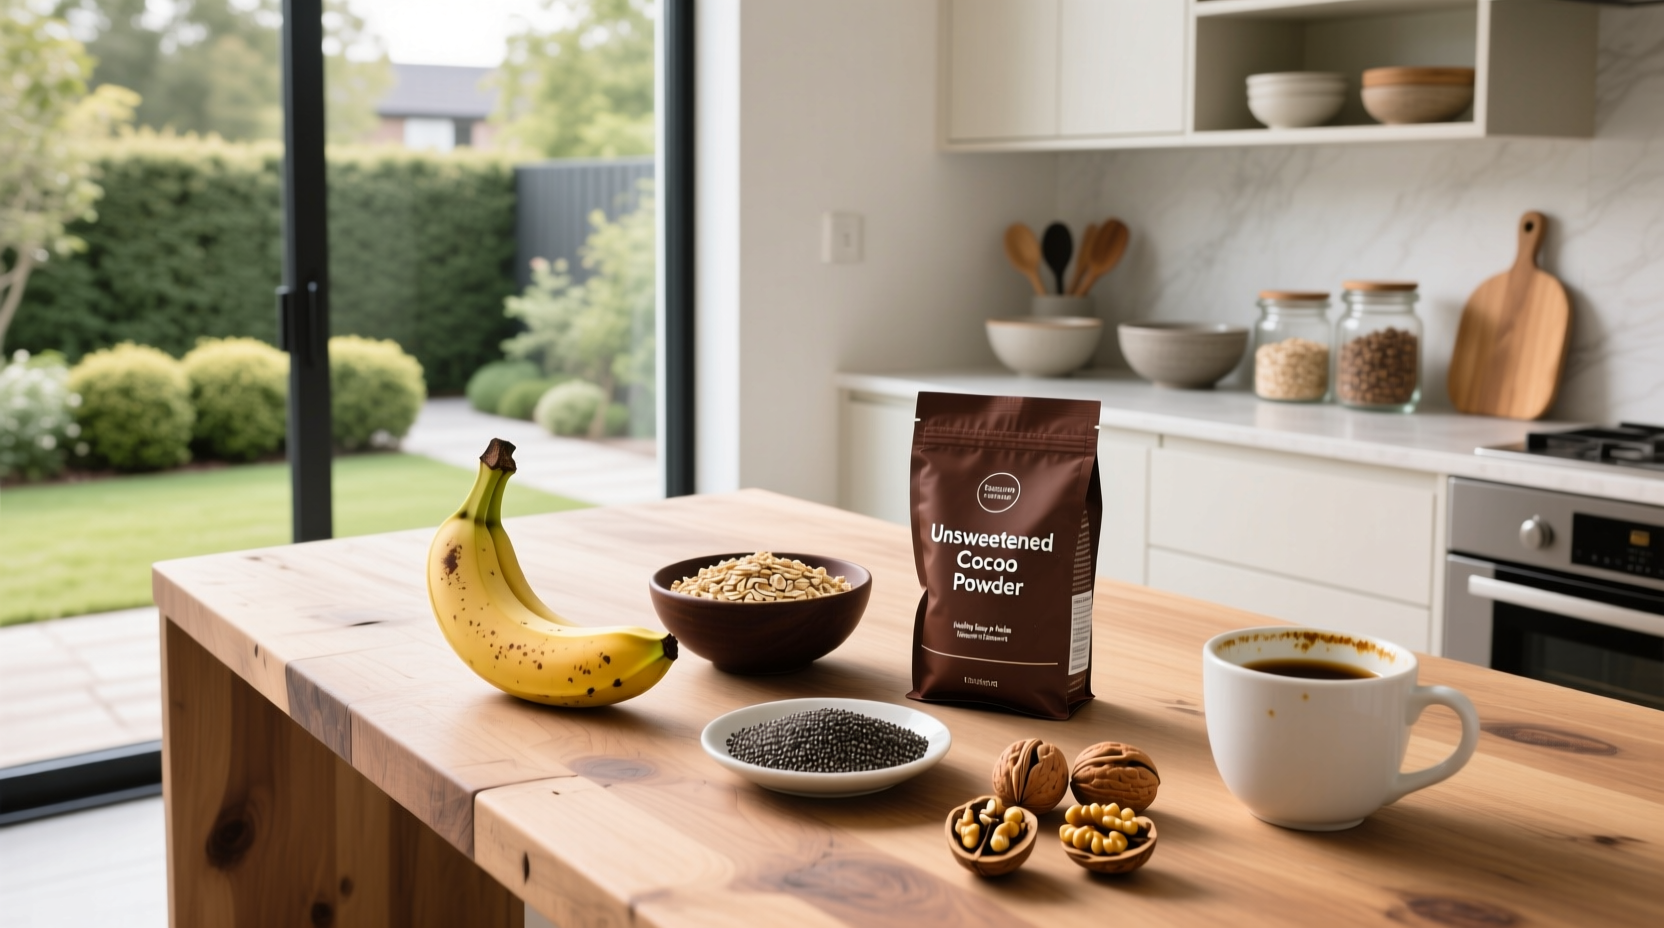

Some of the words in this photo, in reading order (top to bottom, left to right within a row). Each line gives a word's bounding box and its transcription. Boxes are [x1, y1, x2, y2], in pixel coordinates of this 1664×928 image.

[931, 523, 1054, 552] Unsweetened
[957, 550, 1018, 573] Cocoo
[953, 572, 1024, 596] Powder
